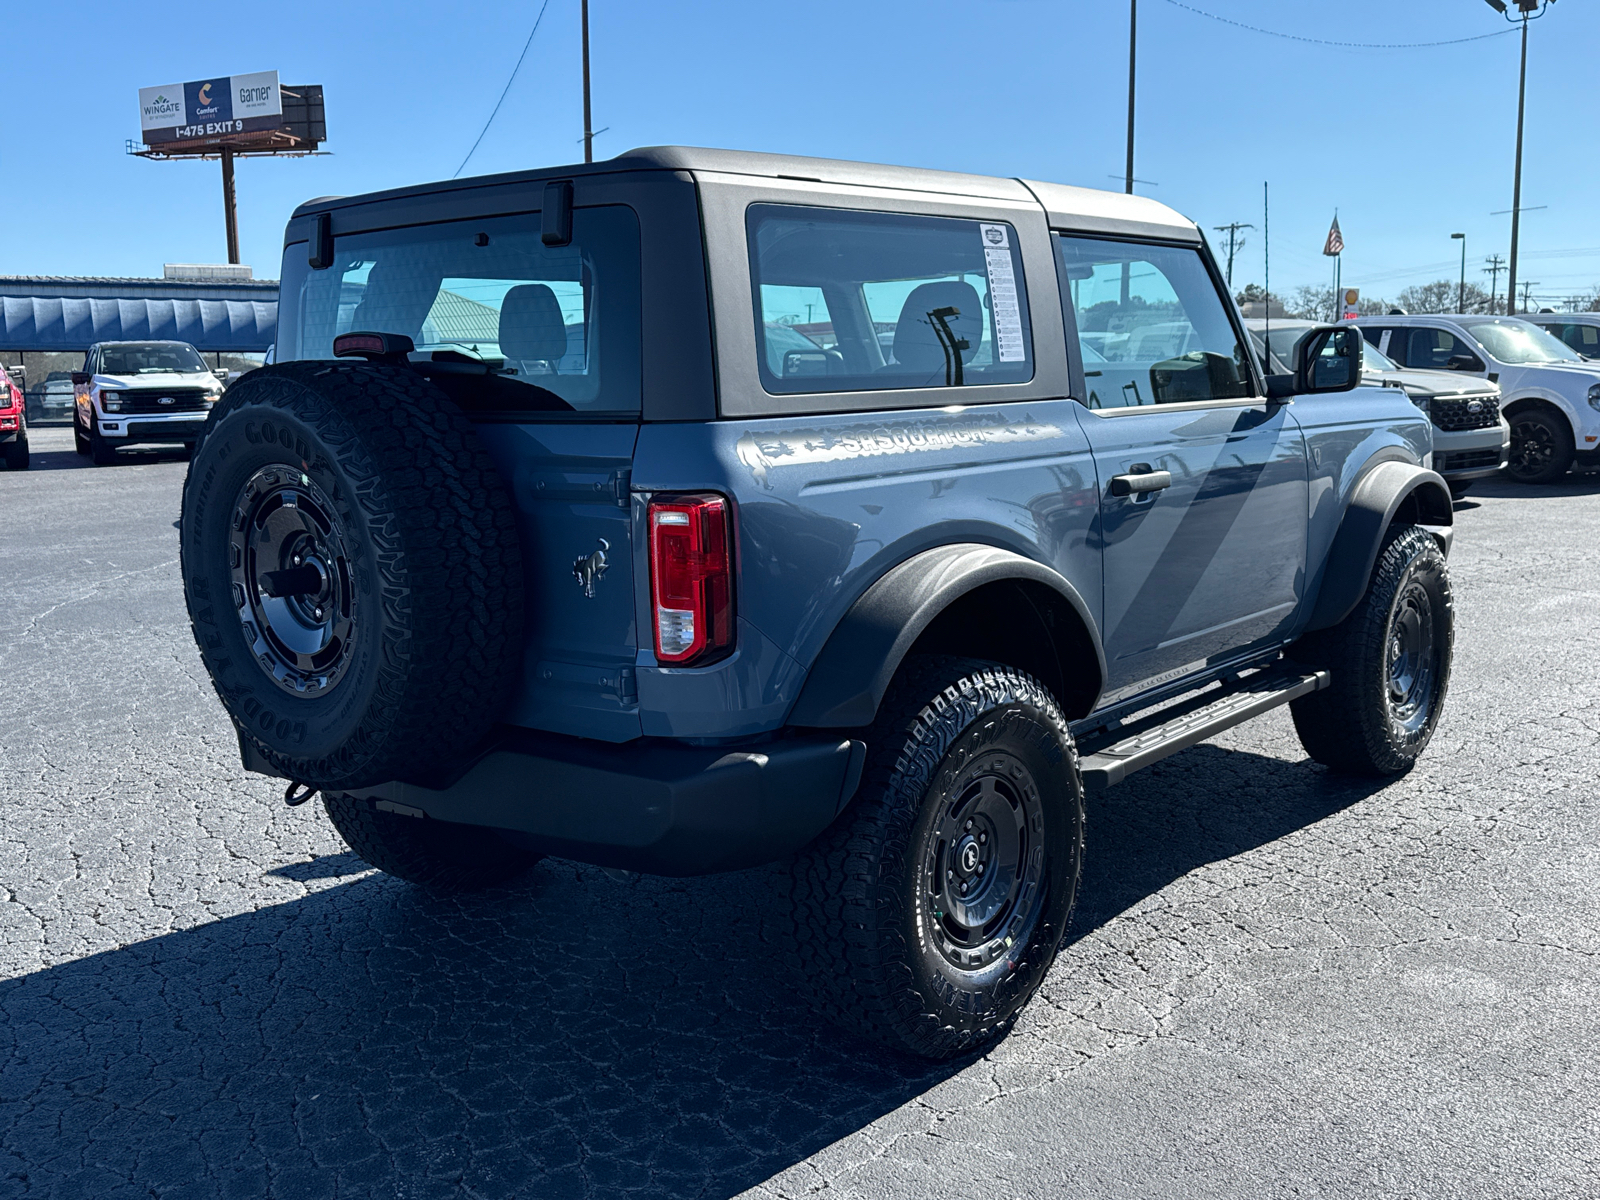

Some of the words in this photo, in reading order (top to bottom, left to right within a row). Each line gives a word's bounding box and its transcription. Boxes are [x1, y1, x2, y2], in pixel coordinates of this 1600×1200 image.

[240, 86, 271, 103] Garner
[144, 103, 180, 115] WINGATE
[196, 107, 218, 115] Comfort
[176, 125, 204, 138] I-475
[206, 121, 234, 134] EXIT
[235, 120, 243, 131] 9
[840, 421, 985, 452] SASQUATCH
[193, 462, 218, 545] TERRITORY
